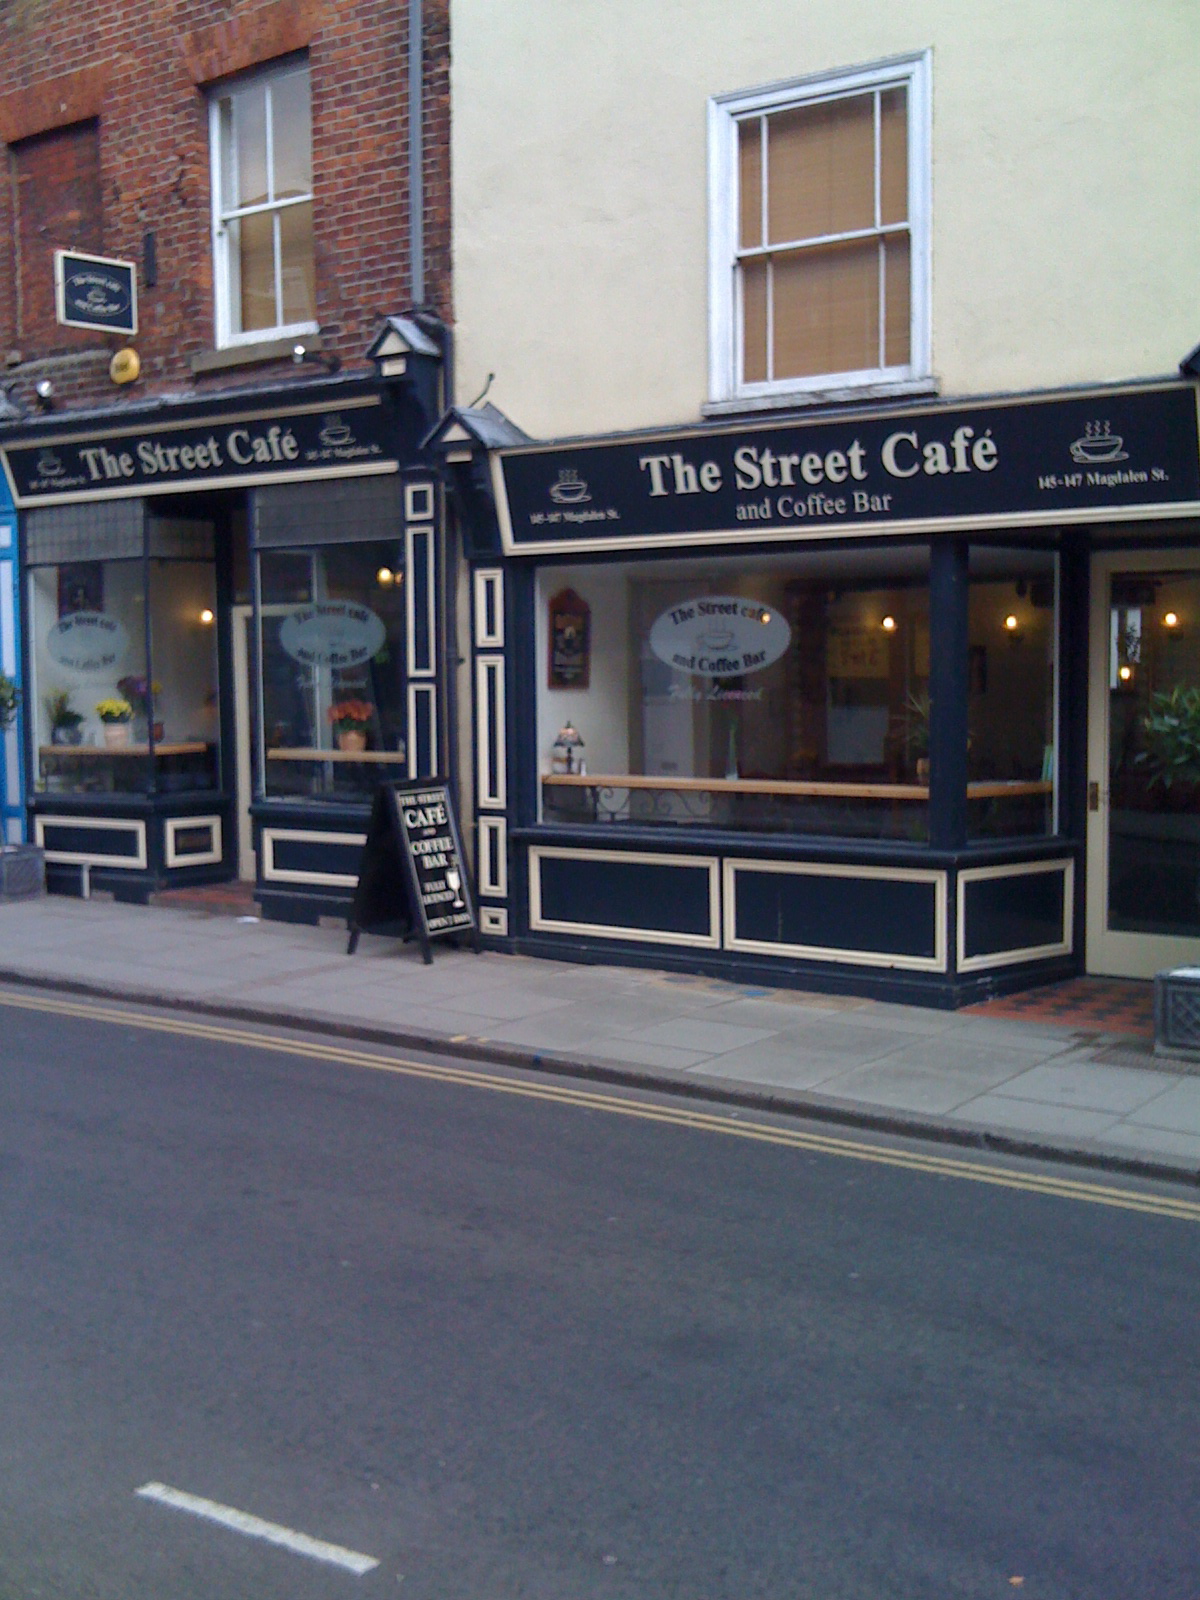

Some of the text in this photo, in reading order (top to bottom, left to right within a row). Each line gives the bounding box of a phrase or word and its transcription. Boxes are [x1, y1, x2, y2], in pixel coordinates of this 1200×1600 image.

[79, 425, 299, 481] The Street Café
[639, 426, 998, 497] The Street Café
[1086, 469, 1148, 488] Magdalen
[1151, 466, 1170, 482] St.
[736, 489, 893, 521] and Coffee Bar
[670, 607, 695, 625] The
[698, 602, 738, 616] Street
[672, 650, 766, 672] and Coffee Bar
[405, 804, 447, 828] CAFÉ
[411, 837, 454, 855] COFFEE
[422, 853, 448, 869] BAR
